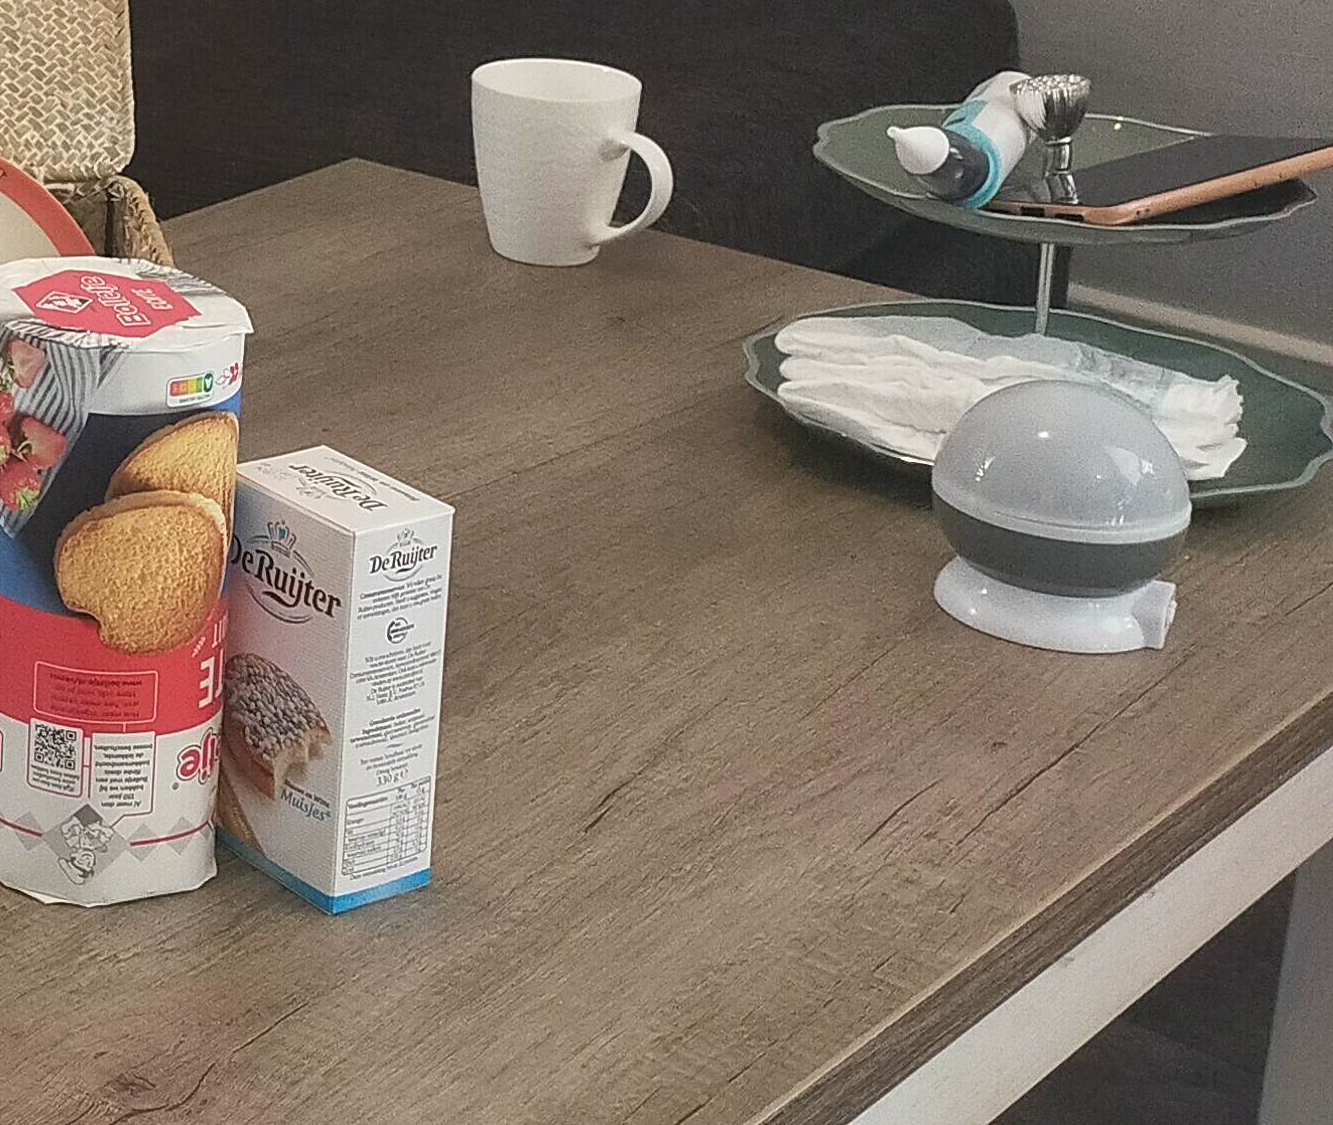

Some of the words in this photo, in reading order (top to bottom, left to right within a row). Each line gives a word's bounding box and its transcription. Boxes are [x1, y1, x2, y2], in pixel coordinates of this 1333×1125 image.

[253, 548, 342, 618] Ruijter
[369, 555, 390, 574] De
[388, 545, 438, 575] Ruijter
